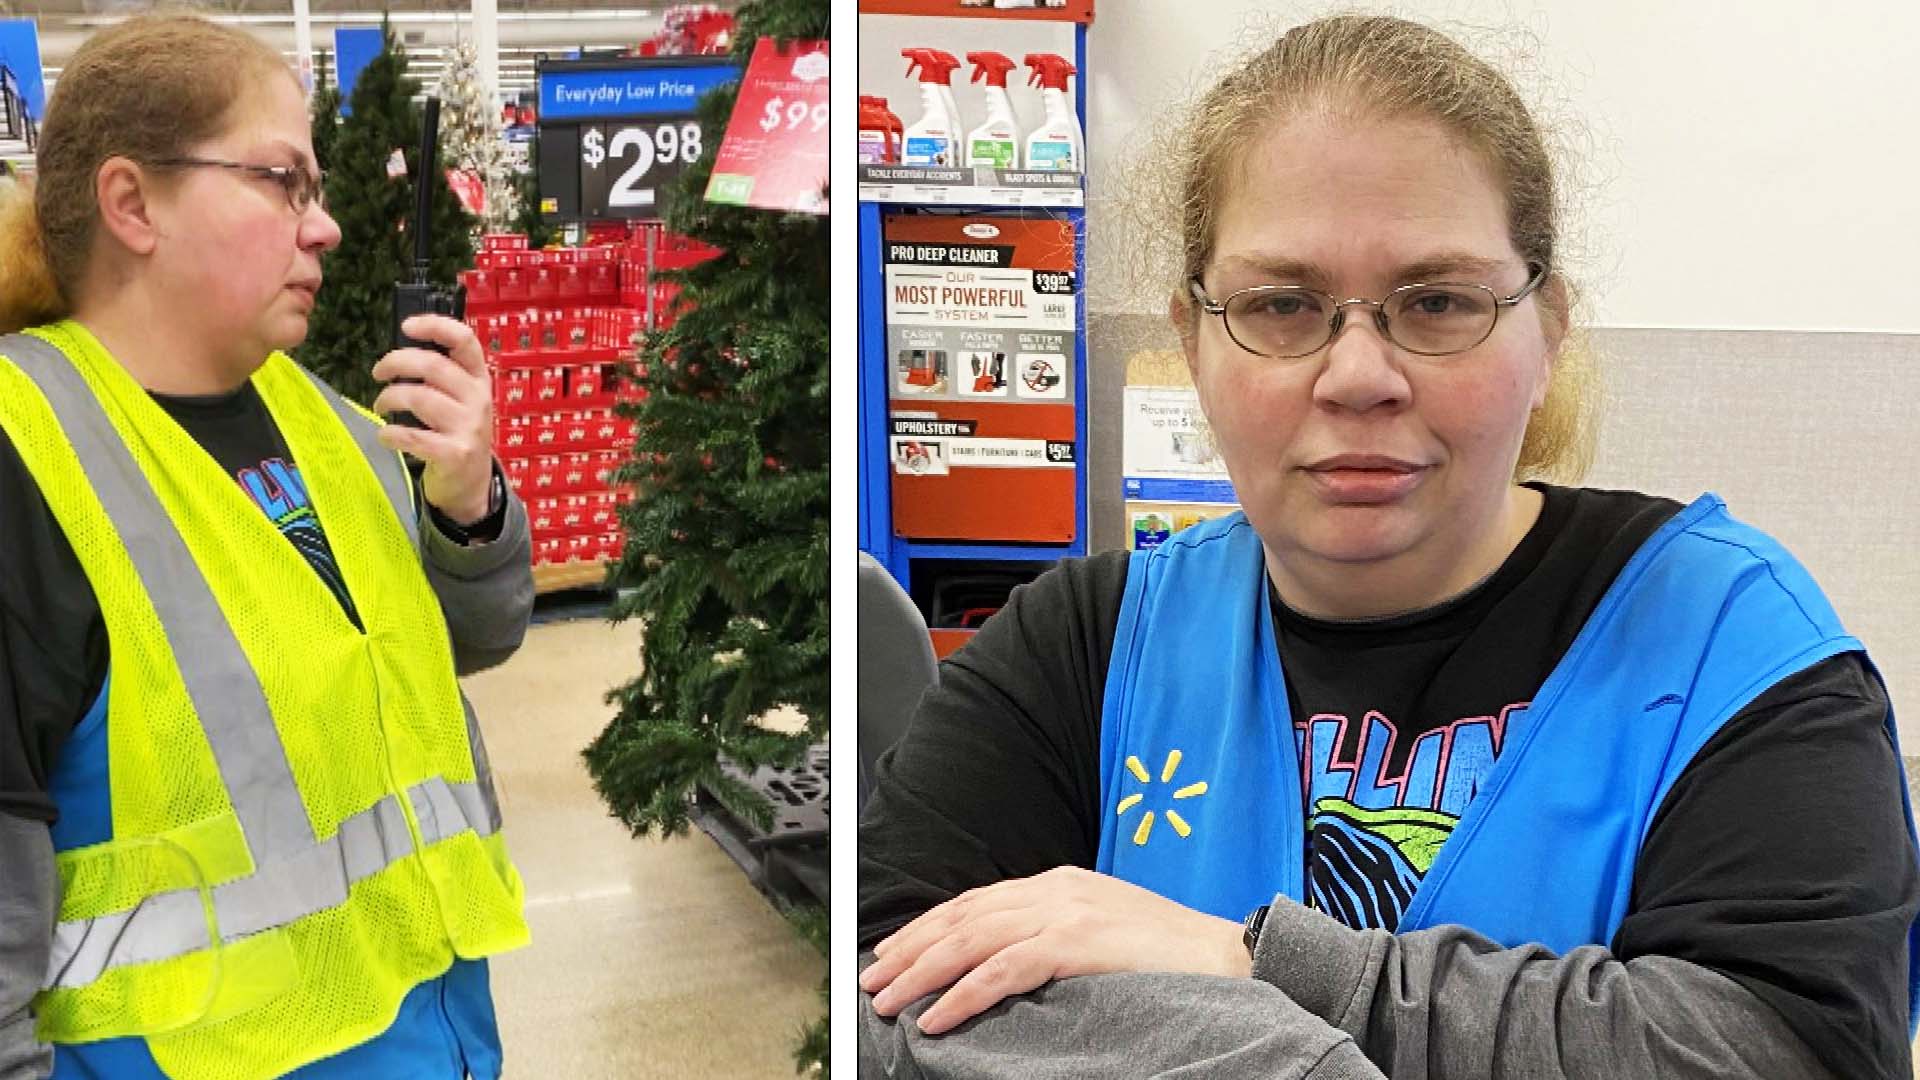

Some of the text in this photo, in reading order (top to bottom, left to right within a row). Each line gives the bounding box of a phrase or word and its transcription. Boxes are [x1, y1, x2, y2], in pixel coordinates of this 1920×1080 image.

[556, 80, 695, 105] Everyday Low Price
[891, 245, 999, 264] PRO DEEP CLEANER
[946, 271, 975, 283] OUR
[895, 285, 1027, 308] MOST POWERFUL
[934, 309, 989, 321] SYSTEM
[902, 329, 944, 340] EASIER
[960, 331, 1004, 342] FASTER
[1018, 333, 1064, 344] BETTER
[1140, 403, 1180, 415] Receive
[895, 421, 958, 435] UPHOLSTERY
[1152, 419, 1165, 428] up
[1168, 418, 1179, 427] to
[1181, 417, 1188, 427] 5
